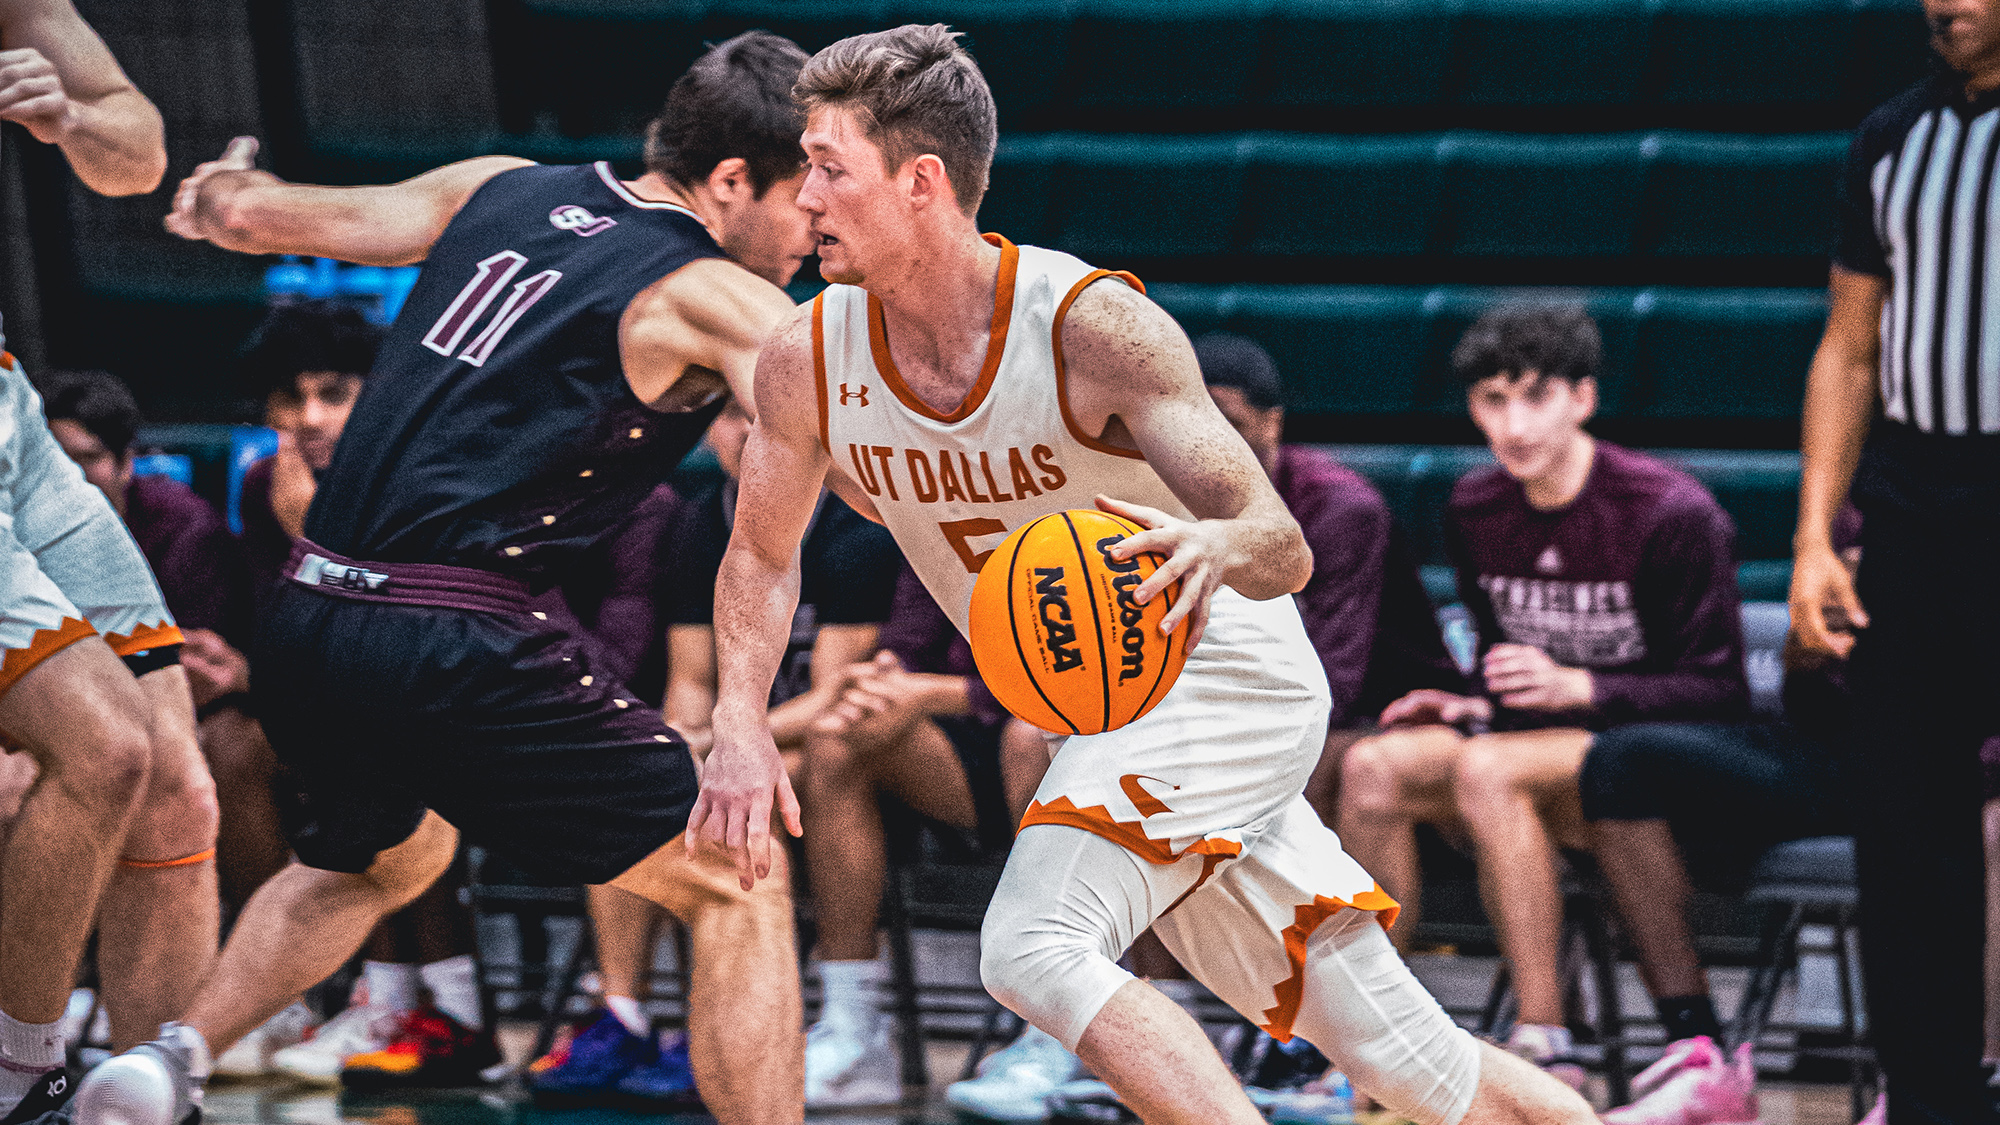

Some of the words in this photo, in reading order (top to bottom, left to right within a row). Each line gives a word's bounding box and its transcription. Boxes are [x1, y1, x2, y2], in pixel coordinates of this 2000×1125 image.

[421, 249, 563, 367] 11
[849, 443, 900, 501] UT
[904, 443, 1068, 503] DALLAS
[1032, 613, 1043, 644] GAME
[1039, 647, 1050, 674] BALL
[1034, 566, 1083, 673] NCAA
